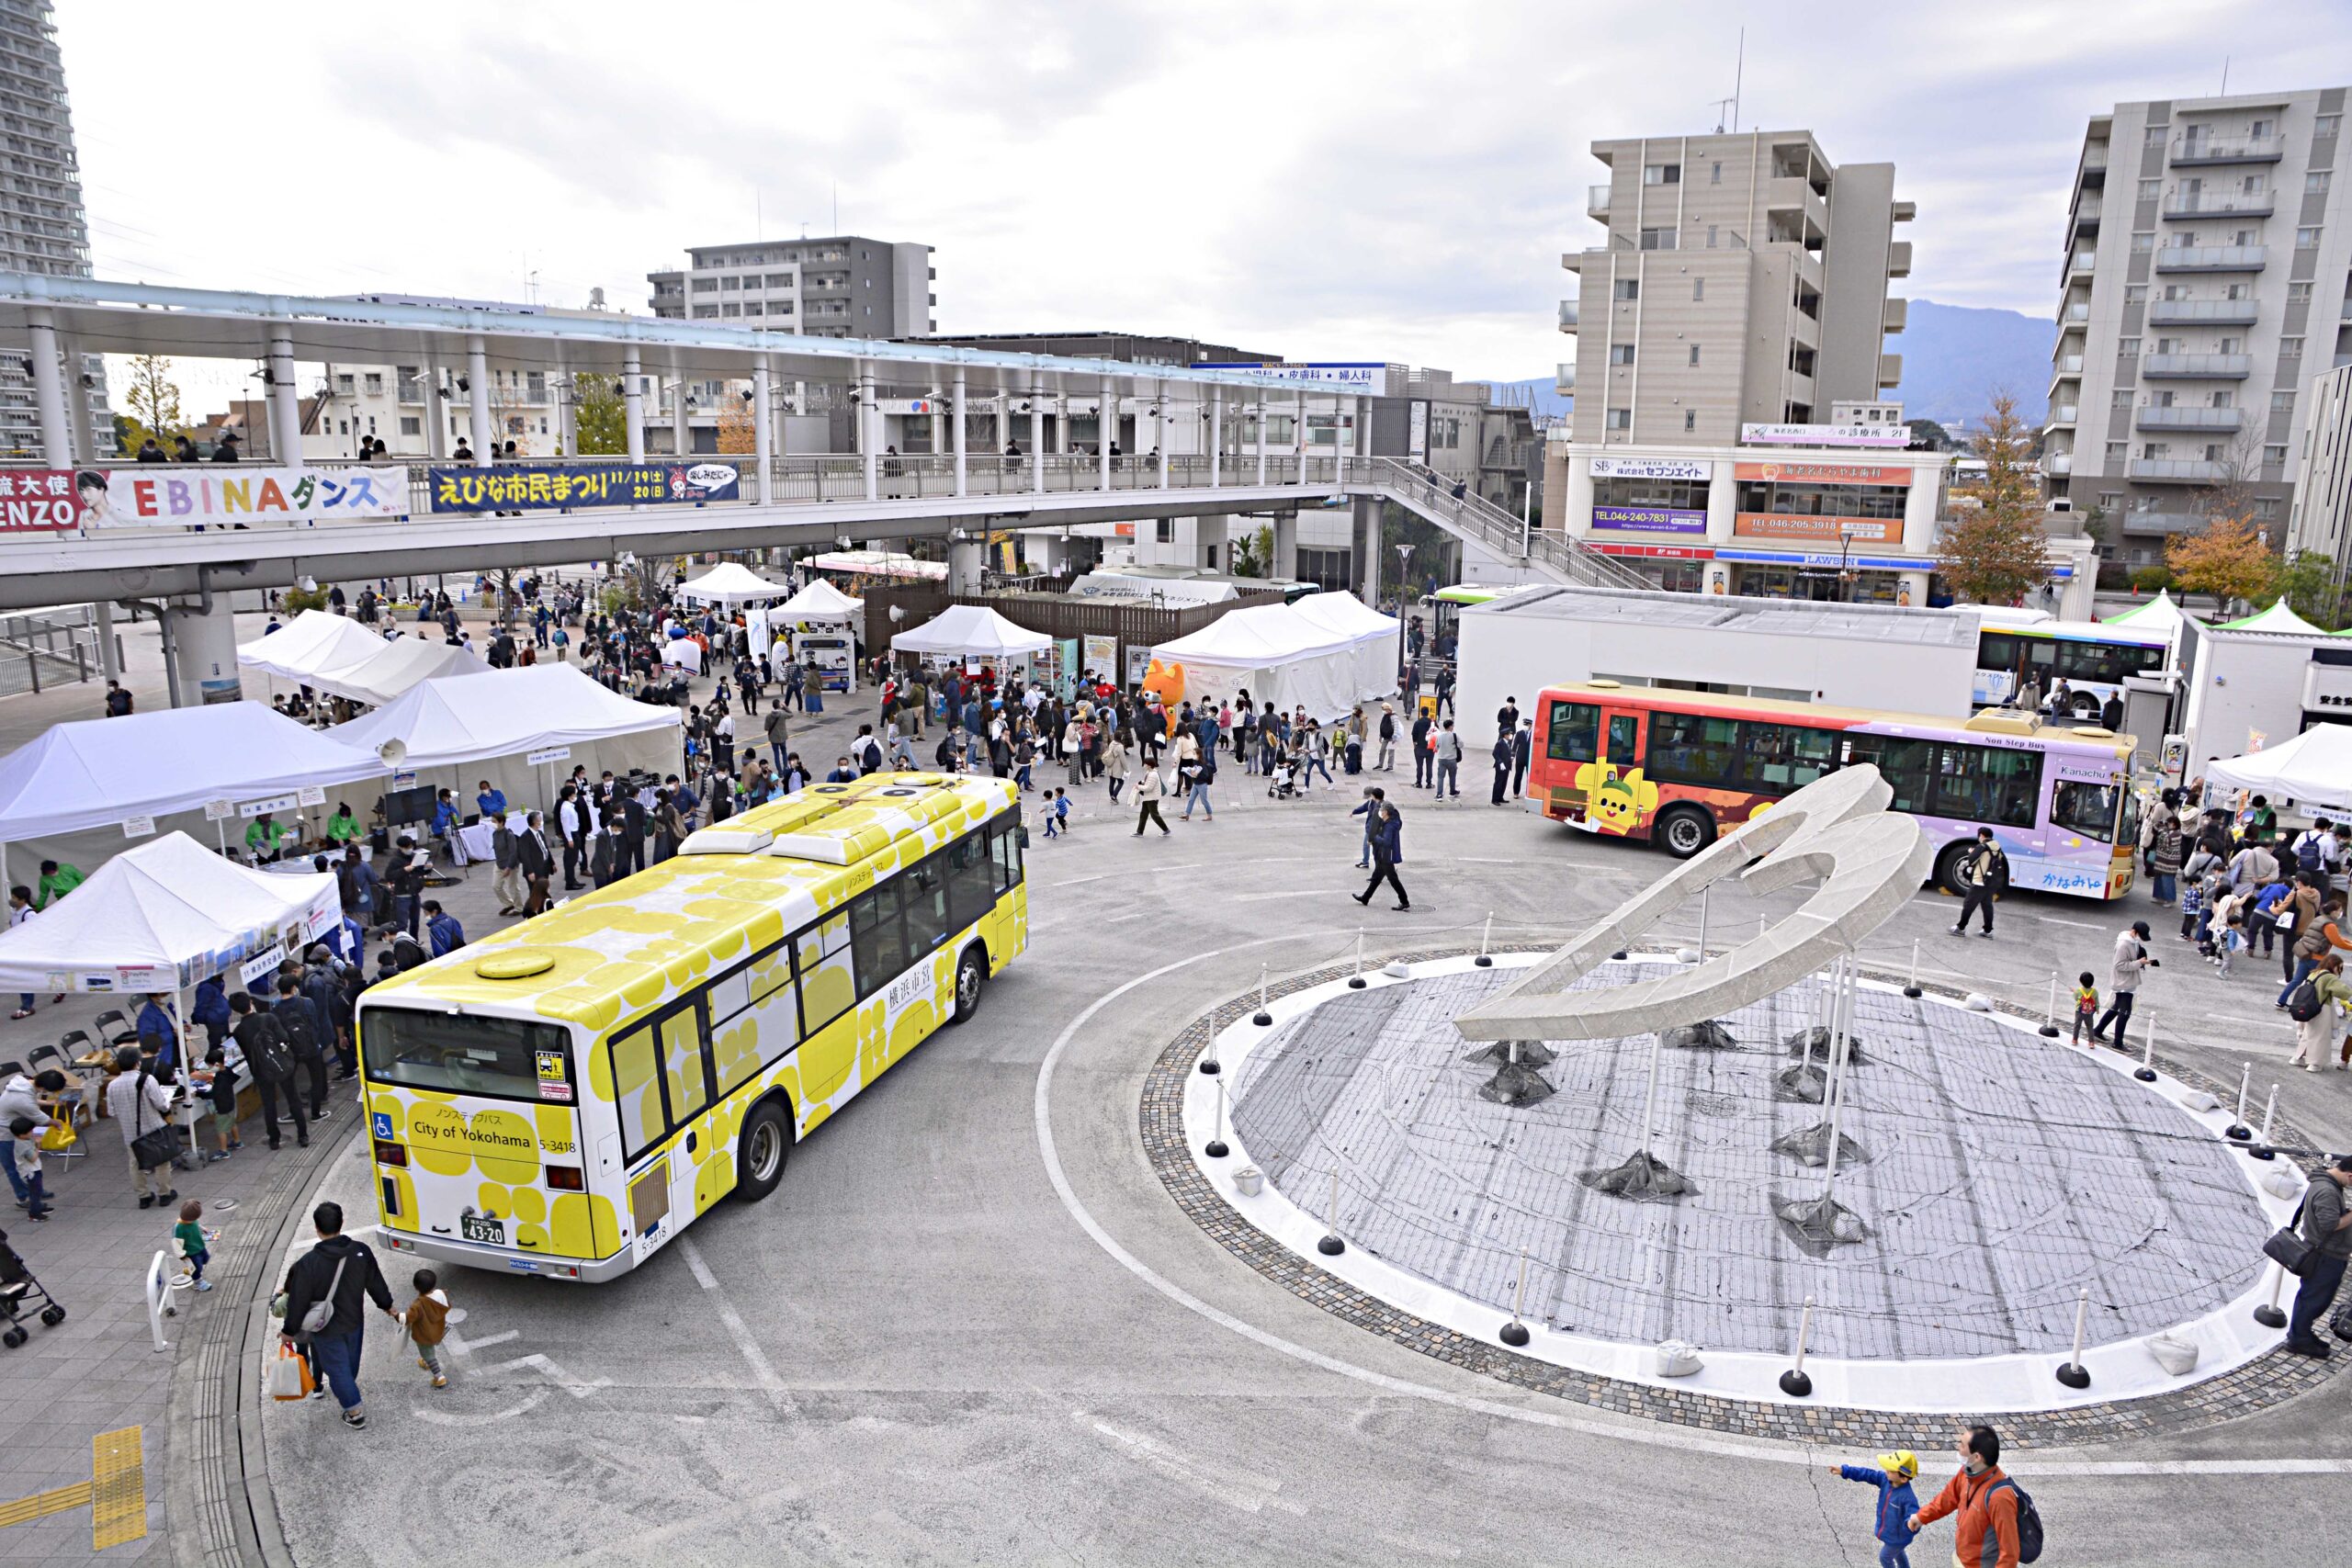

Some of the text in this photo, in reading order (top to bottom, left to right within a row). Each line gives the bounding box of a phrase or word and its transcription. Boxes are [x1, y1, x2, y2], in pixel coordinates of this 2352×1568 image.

[1339, 369, 1372, 381] 婦人科
[1617, 466, 1702, 478] 株式会社 セブンエイト
[1785, 464, 1882, 478] 海老名むらやま歯科
[438, 469, 607, 503] えびな市民まつり
[633, 486, 665, 499] 20(日)
[1807, 555, 1856, 566] LAWSON
[1985, 736, 2045, 750] Non Step Bus
[2061, 766, 2106, 779] Kanachu
[889, 963, 931, 1009] 横浜市営
[435, 1109, 503, 1125] ノンステップバス
[414, 1121, 530, 1148] City of Yokohama
[539, 1139, 576, 1153] 5-3418
[469, 1224, 503, 1243] 43-20
[641, 1225, 668, 1255] 5-3418
